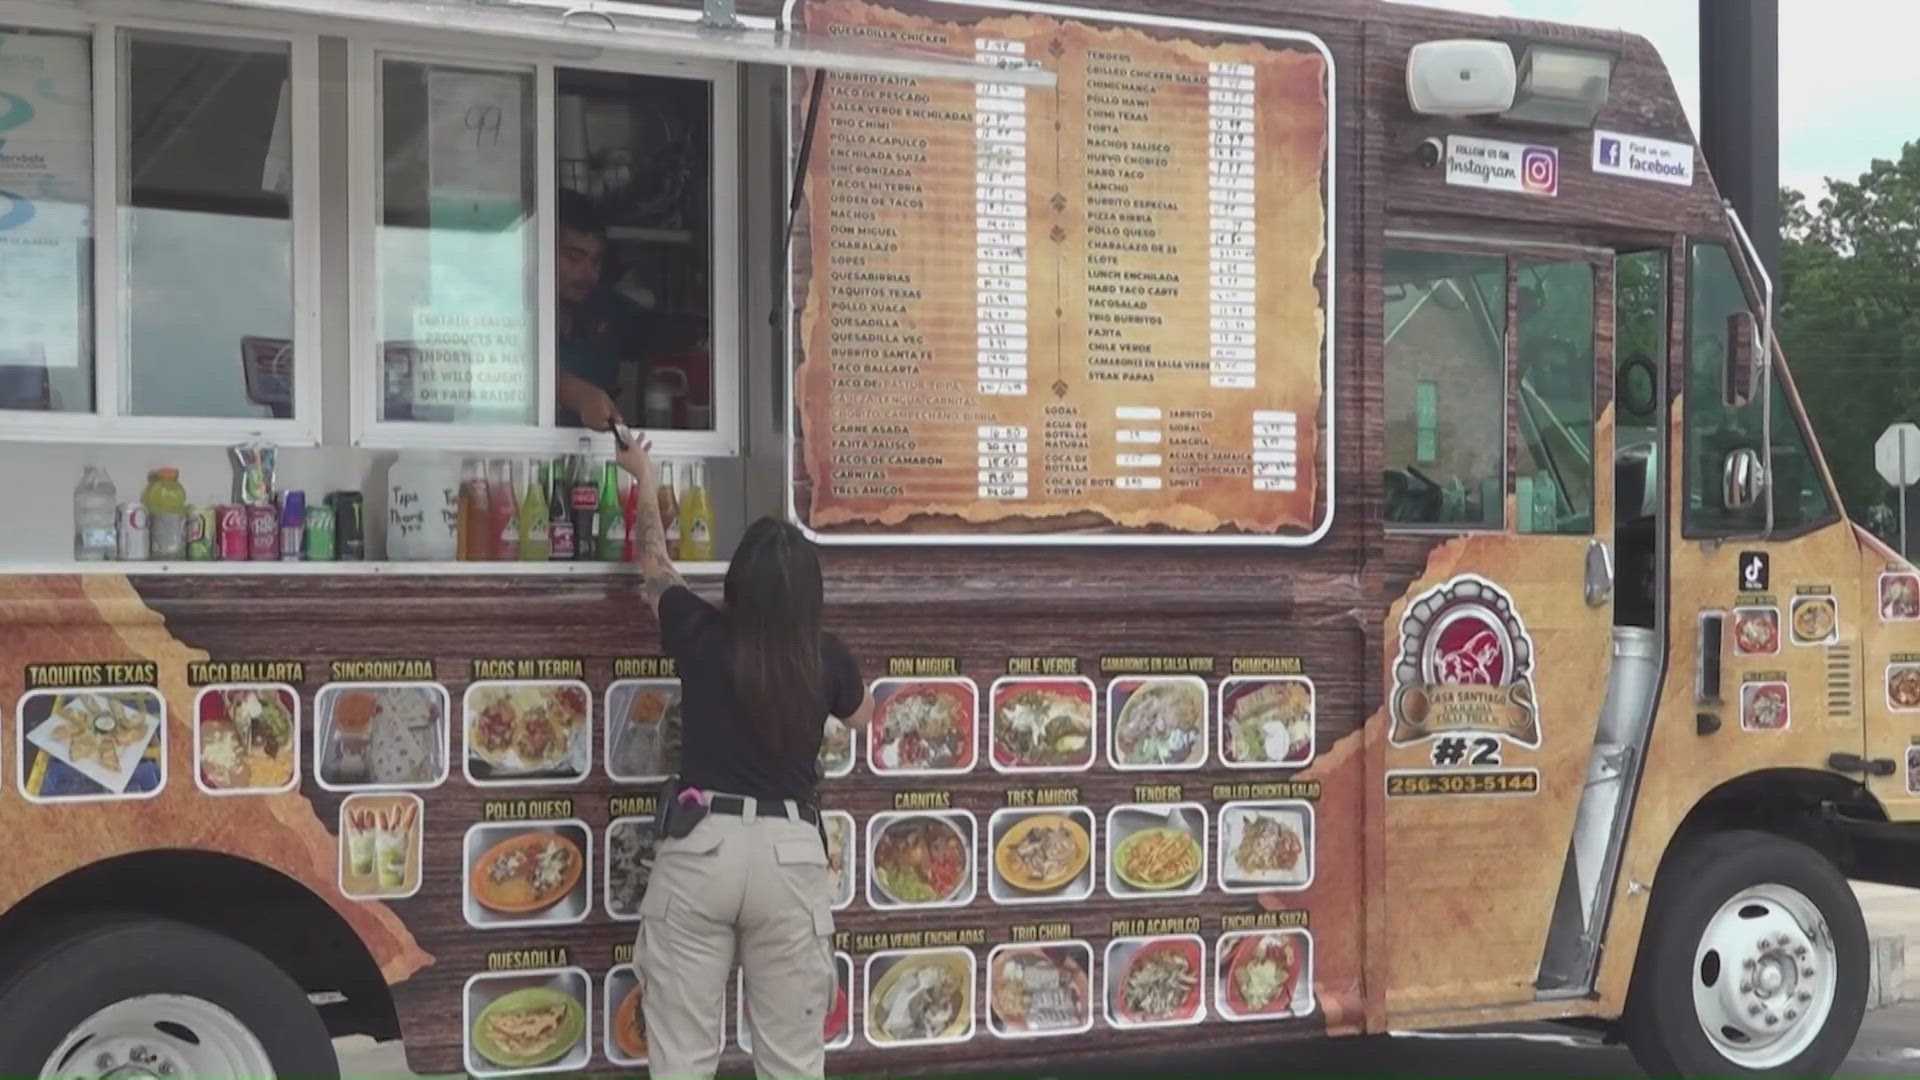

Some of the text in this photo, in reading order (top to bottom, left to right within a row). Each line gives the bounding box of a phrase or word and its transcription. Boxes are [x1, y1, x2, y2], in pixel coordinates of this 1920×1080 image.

[1448, 156, 1516, 183] Instagram
[392, 486, 418, 508] Tips
[391, 509, 424, 524] Thank
[401, 524, 421, 538] you
[191, 662, 303, 683] TACO BALLARTA
[332, 660, 432, 679] SINCRONIZADA
[474, 660, 582, 678] TACOS MI TERRIA
[615, 659, 676, 675] ORDEN DE
[890, 659, 956, 674] DON MIGUEL
[1009, 658, 1077, 673] CHILE VERDE
[1232, 658, 1301, 673] CHIMICHANGA
[30, 664, 154, 685] TAQUITOS TEXAS
[1433, 738, 1500, 765] #2
[1213, 784, 1320, 800] GRILLED CHICKEN SALAD
[1391, 776, 1534, 792] 256-303-5144
[895, 793, 950, 808] CARNITAS
[1008, 790, 1078, 806] TRES AMIGOS
[1136, 787, 1181, 800] TENDERS
[486, 800, 571, 819] POLLO QUESO
[1112, 918, 1200, 936] POLLO ACAPULCO
[1222, 912, 1308, 929] ENCHILADA SUIZA
[836, 933, 849, 948] FE
[856, 930, 984, 949] SALSA VERDE ENCHILADAS
[1013, 925, 1070, 941] TRIO CHIMI
[488, 949, 567, 969] QUESADILLA
